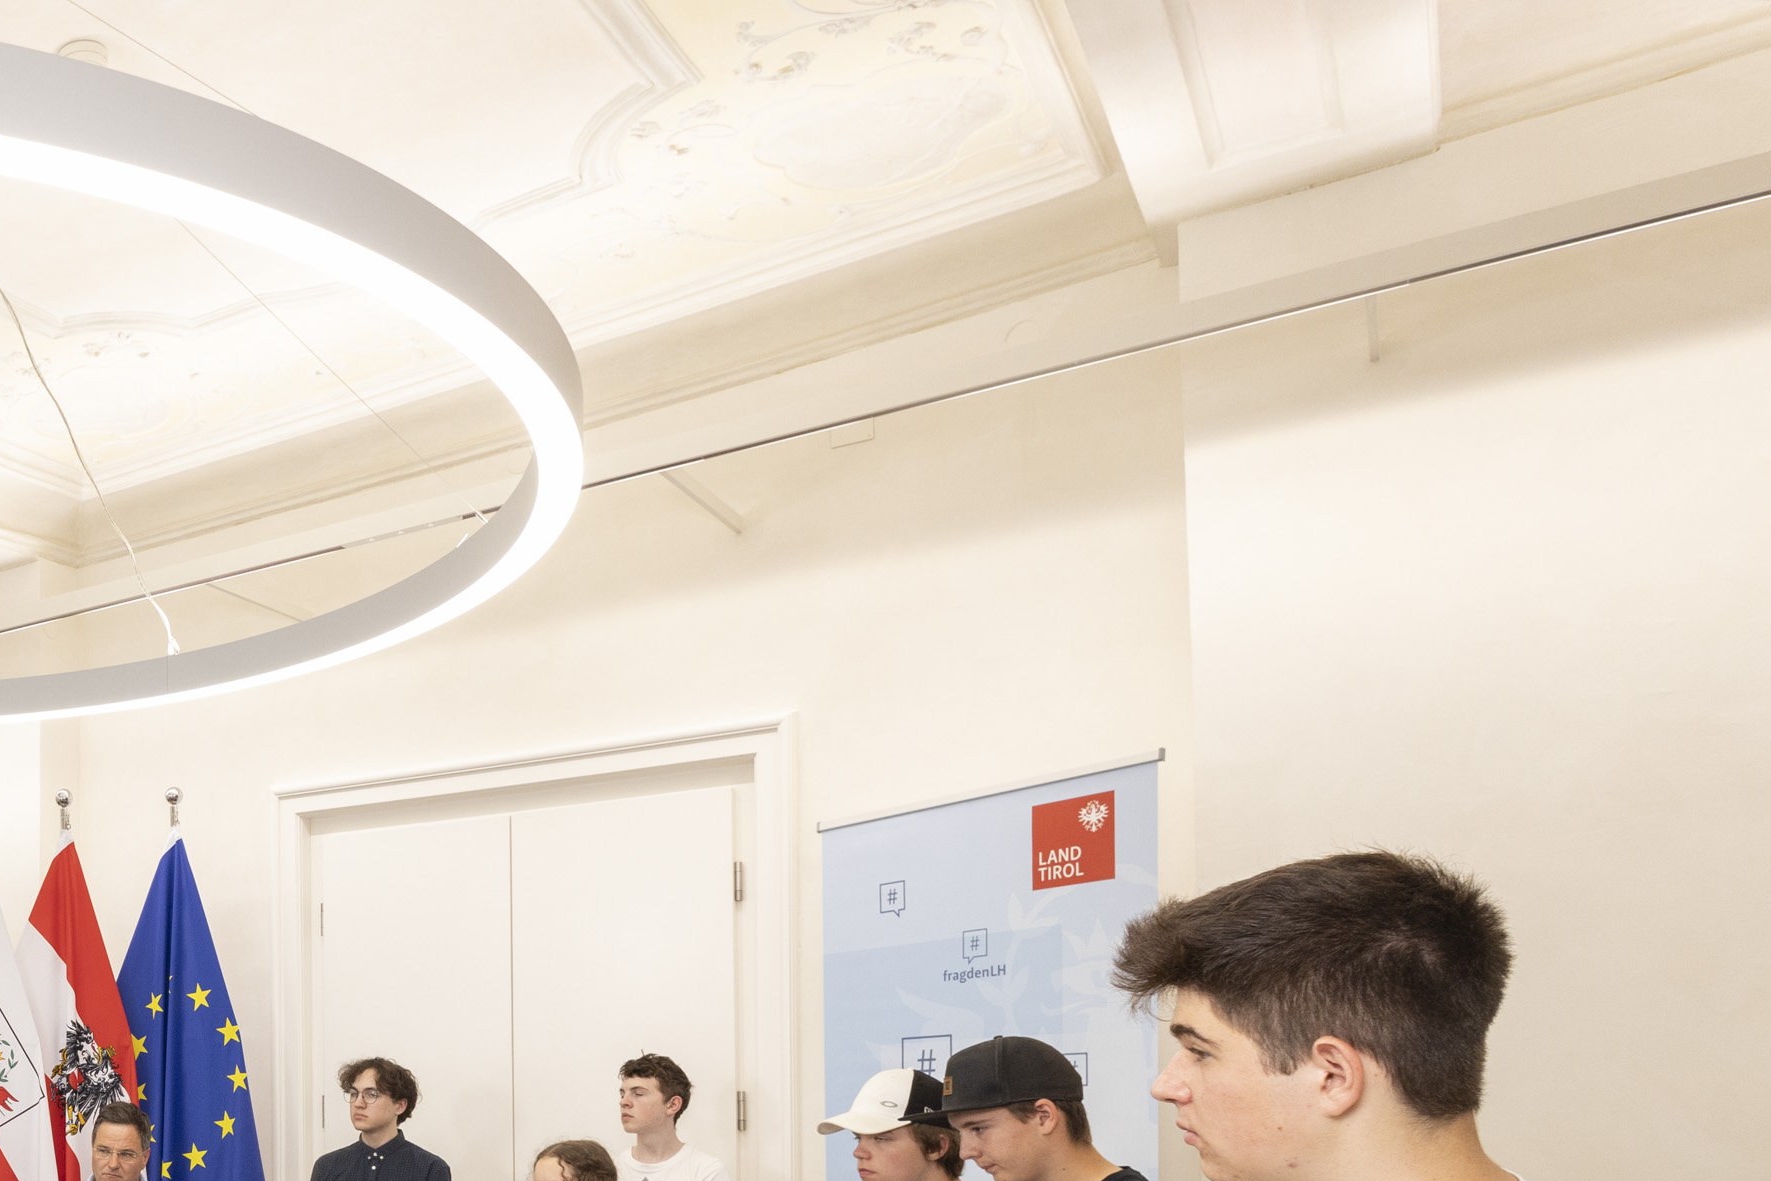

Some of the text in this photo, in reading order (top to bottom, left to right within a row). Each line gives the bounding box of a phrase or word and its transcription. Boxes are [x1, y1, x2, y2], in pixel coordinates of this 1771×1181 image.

[1038, 845, 1082, 866] LAND
[1037, 861, 1084, 882] TIROL
[943, 964, 1007, 984] fragdenLH
